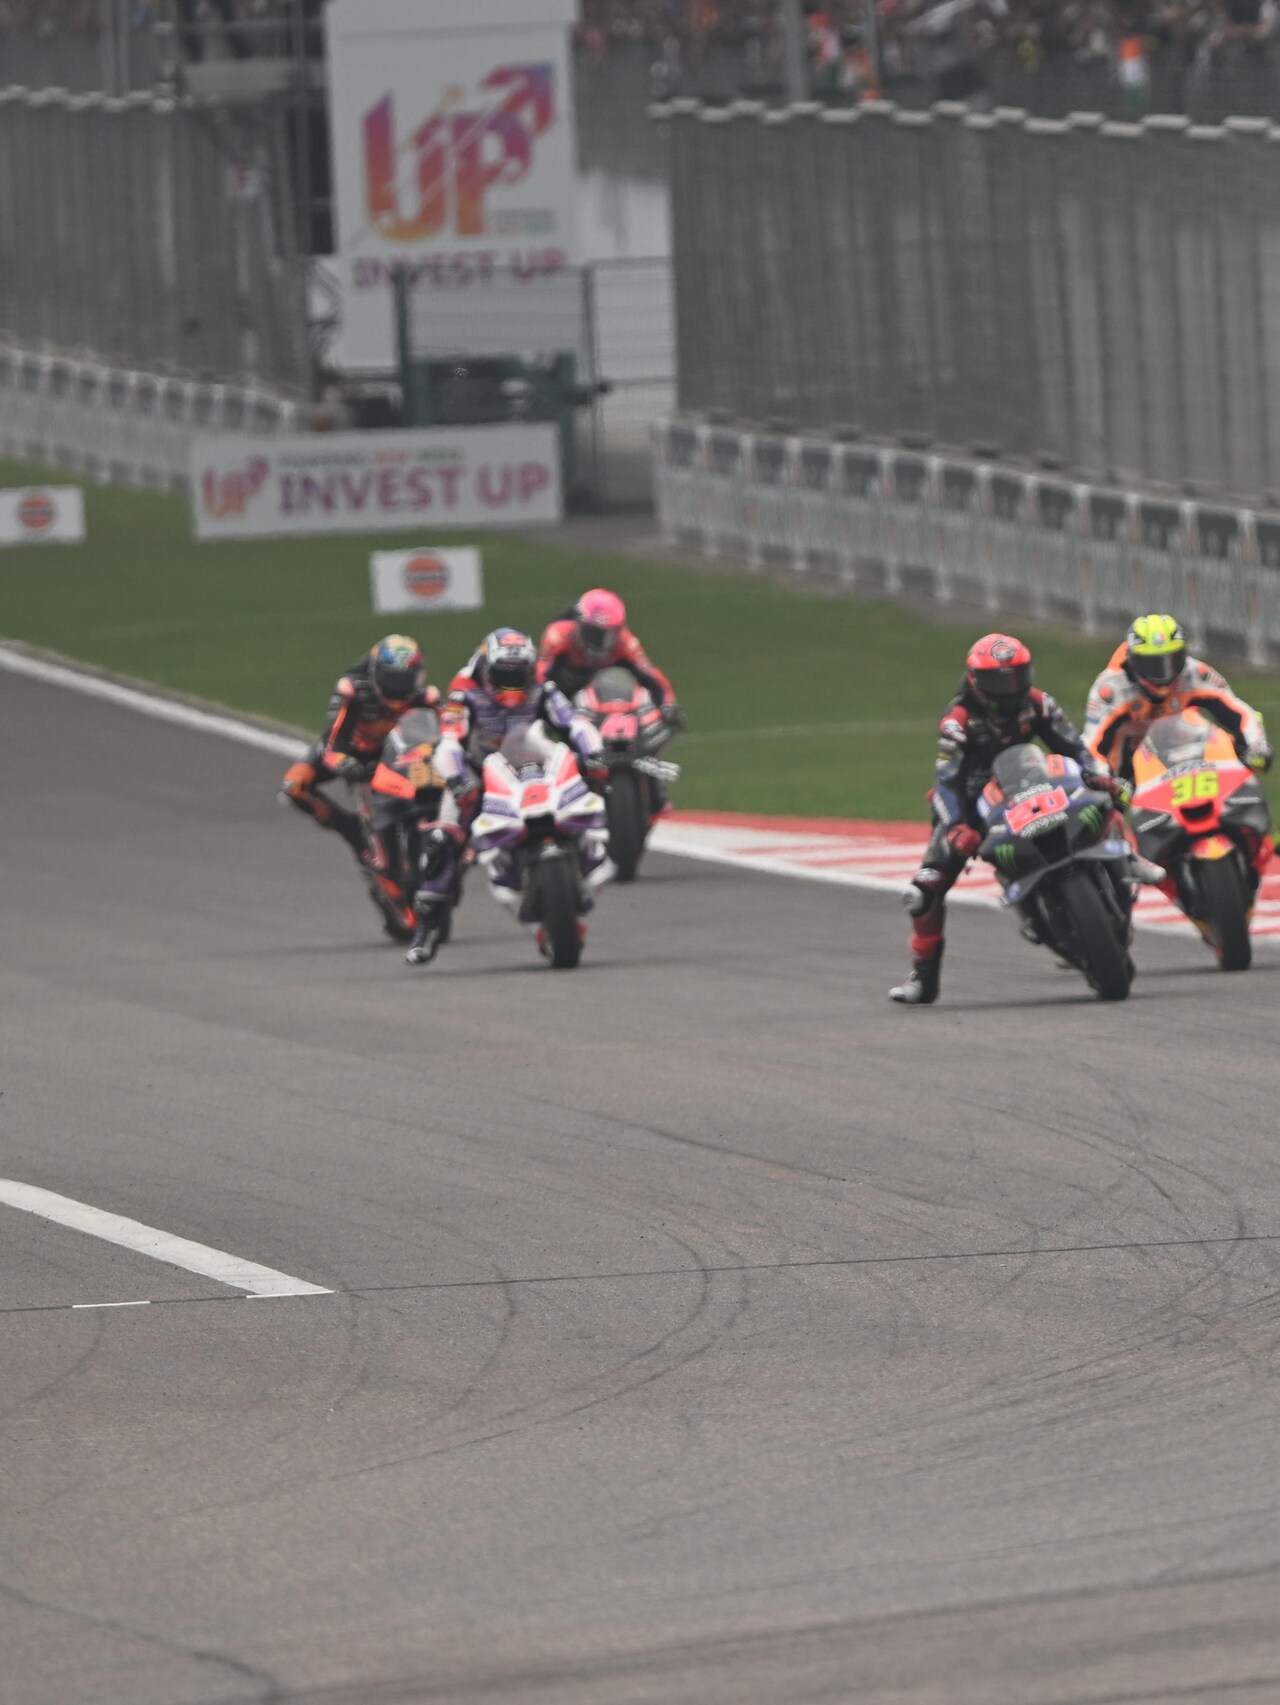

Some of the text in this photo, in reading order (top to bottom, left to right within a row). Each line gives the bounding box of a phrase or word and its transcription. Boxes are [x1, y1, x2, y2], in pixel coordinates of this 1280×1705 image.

[280, 461, 550, 515] INVEST UP
[1171, 770, 1218, 806] 36
